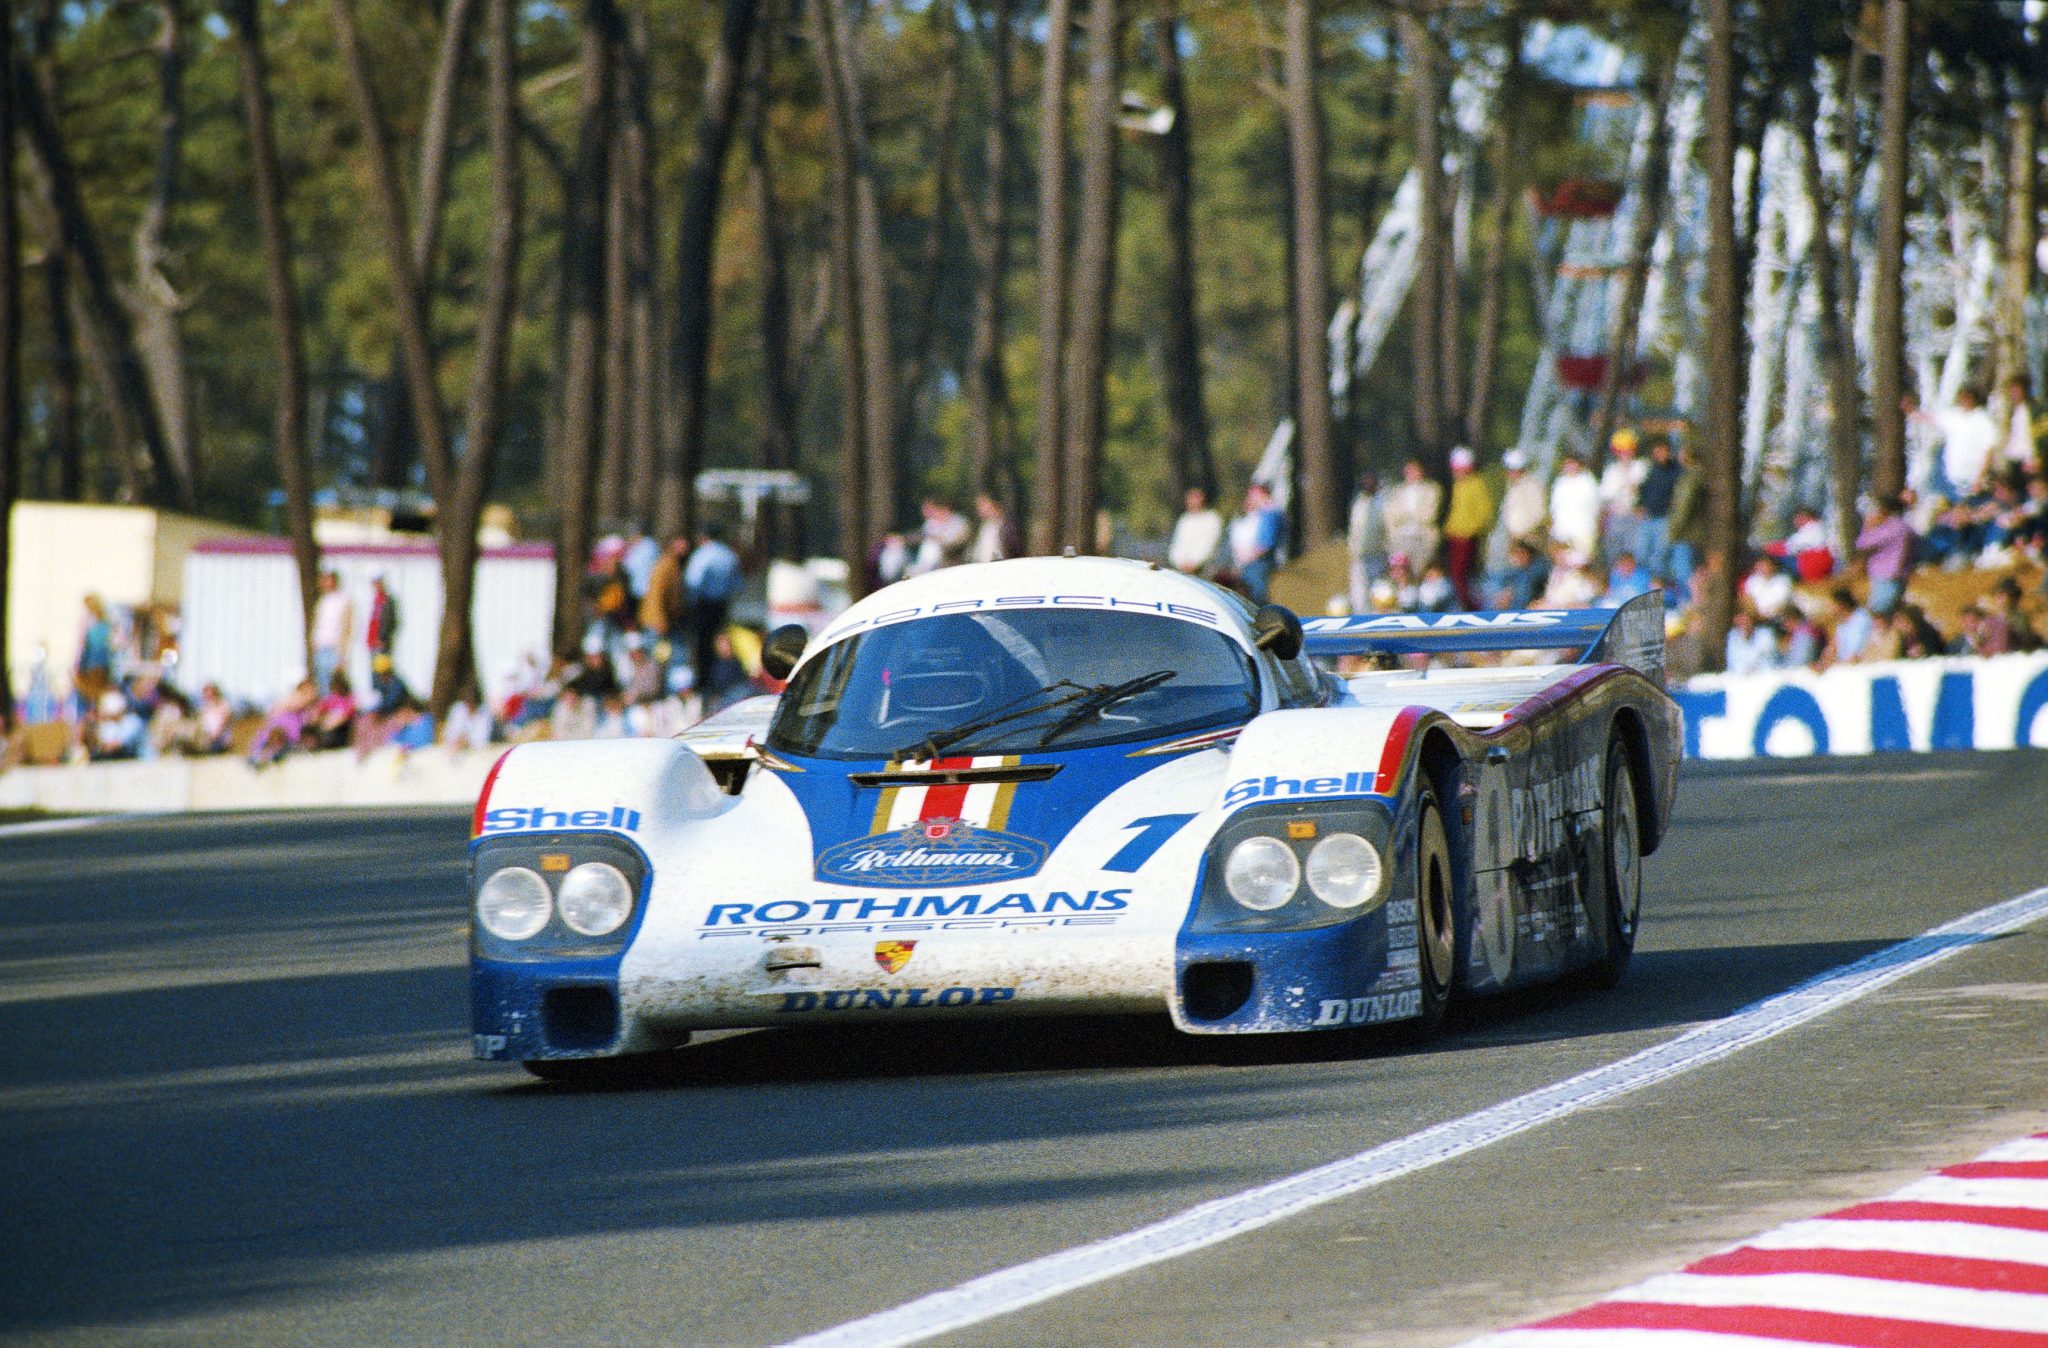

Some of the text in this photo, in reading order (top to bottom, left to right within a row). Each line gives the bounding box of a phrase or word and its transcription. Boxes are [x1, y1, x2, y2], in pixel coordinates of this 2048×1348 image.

[826, 595, 1218, 641] PORSCHE
[1223, 771, 1377, 809] Shell
[484, 806, 641, 832] Shell
[841, 848, 1019, 872] Rothmans
[1101, 812, 1201, 873] 1
[704, 888, 1132, 926] ROTHMANS
[699, 917, 1119, 940] PORSCHE
[779, 987, 1017, 1012] DUNLOP
[1312, 989, 1422, 1026] DUNLOP
